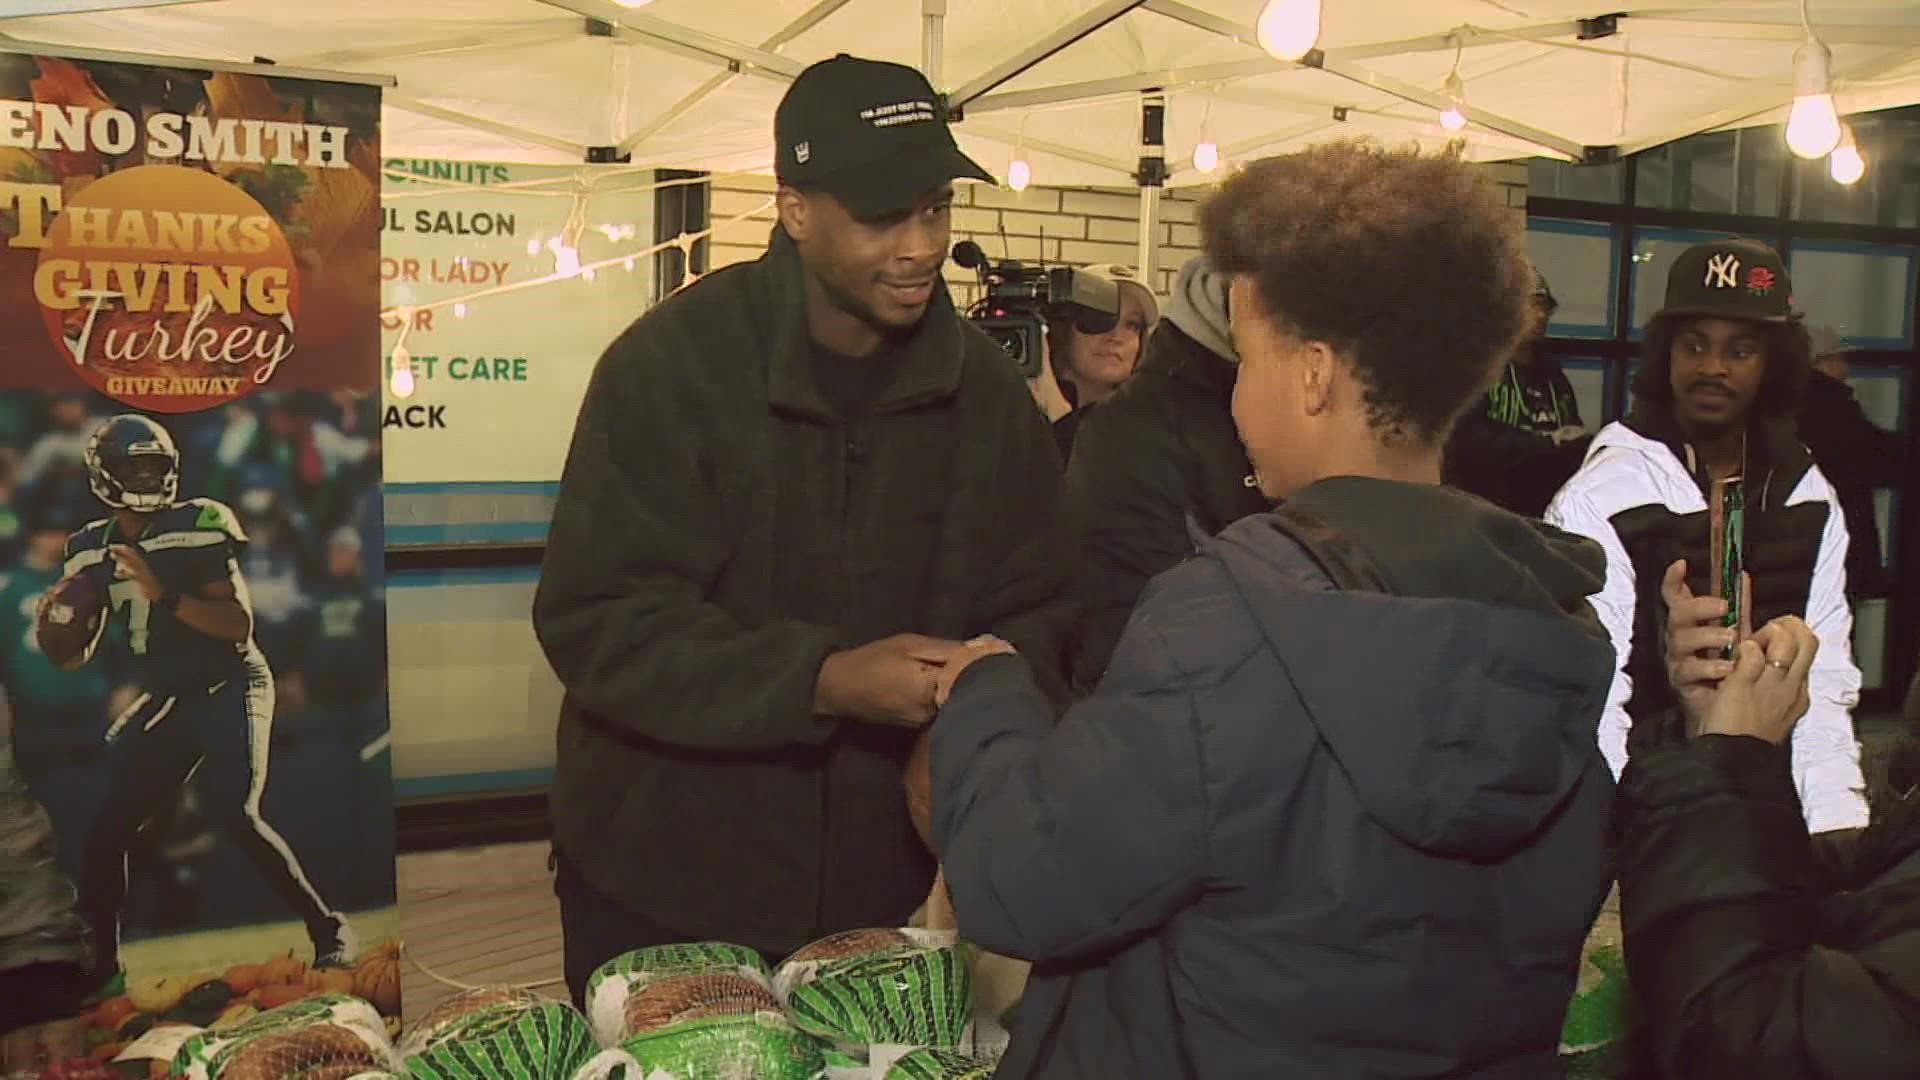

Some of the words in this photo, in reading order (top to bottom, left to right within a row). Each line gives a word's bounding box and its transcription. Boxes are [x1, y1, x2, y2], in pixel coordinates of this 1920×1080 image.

[0, 99, 136, 154] ENO
[147, 112, 349, 168] SMITH
[0, 181, 271, 253] THANKS
[415, 210, 514, 236] SALON
[381, 258, 420, 282] OR
[431, 259, 509, 285] LADY
[1704, 253, 1741, 288] NY
[34, 259, 289, 316] GIVING
[64, 289, 295, 383] Turkey
[448, 357, 528, 381] CARE
[106, 376, 241, 396] GIVEAWAY
[383, 405, 446, 428] ACK
